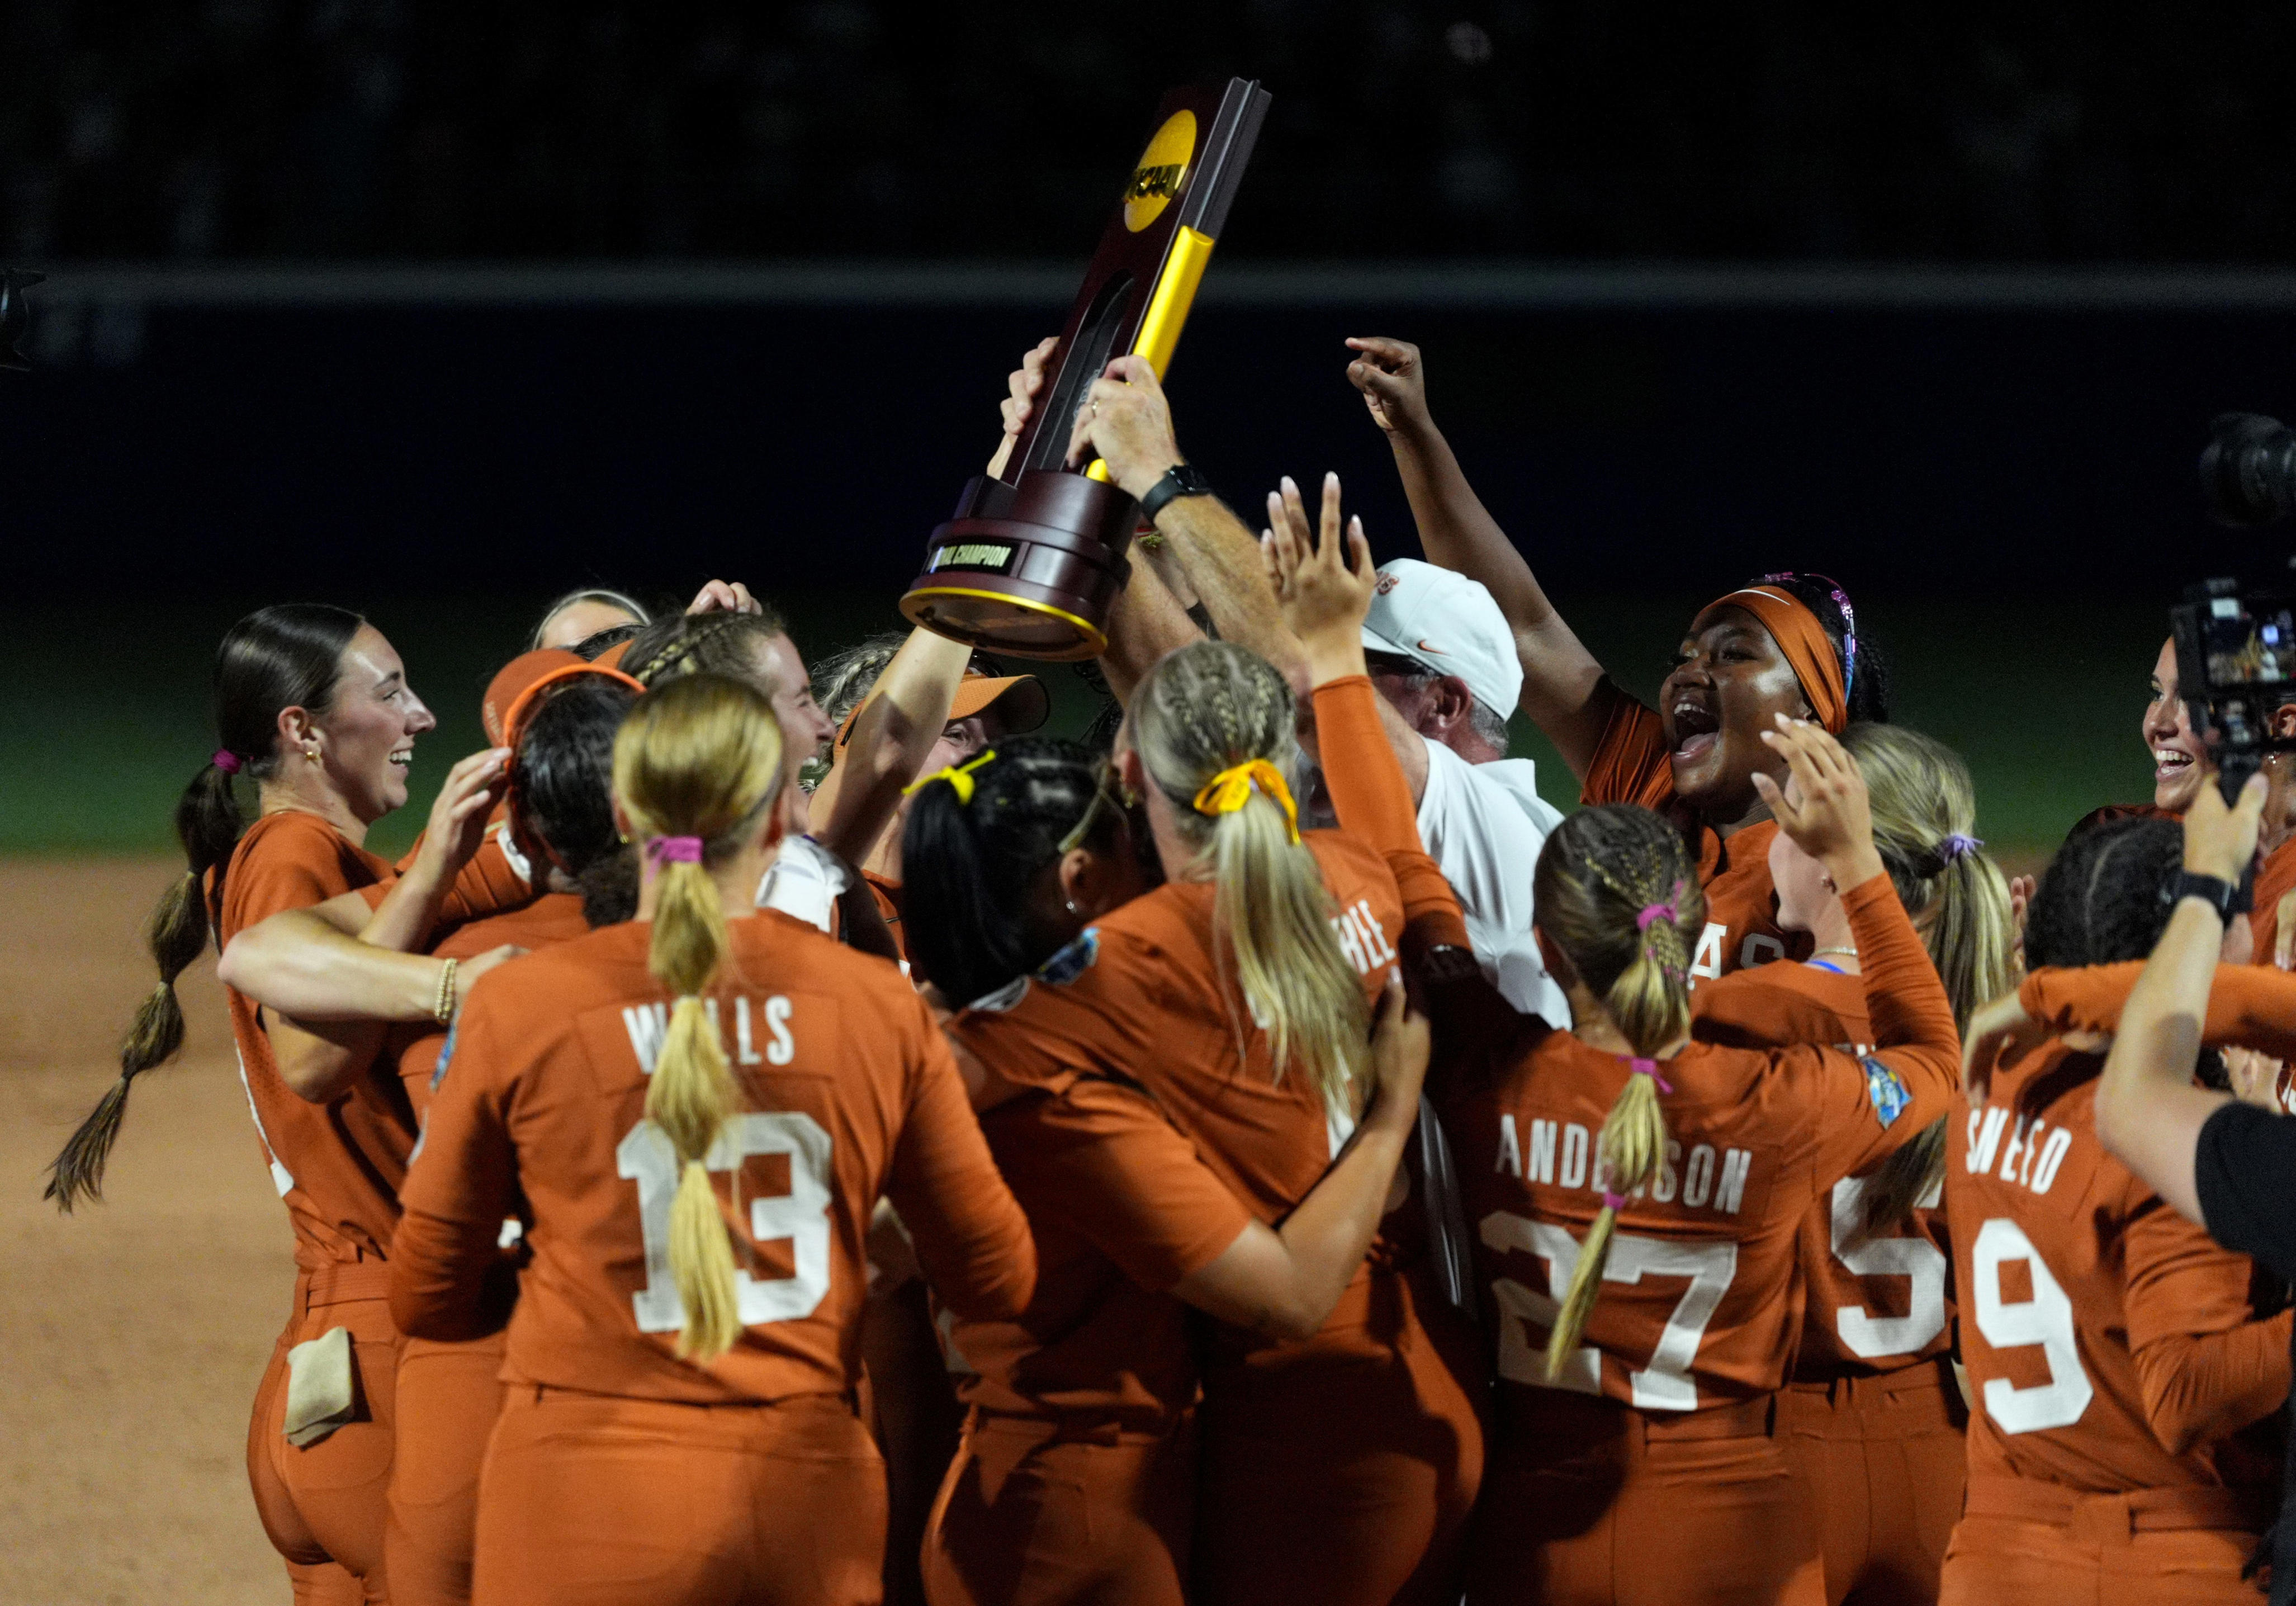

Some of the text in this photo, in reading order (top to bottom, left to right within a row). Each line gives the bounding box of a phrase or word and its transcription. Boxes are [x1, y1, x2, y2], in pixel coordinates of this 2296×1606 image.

[952, 544, 1011, 567] CHAMPION
[622, 994, 794, 1074] WLLS
[617, 1112, 832, 1333] 13
[1495, 1114, 1752, 1214] ANDESON
[1480, 1210, 1739, 1411] 27
[1831, 1176, 1947, 1358] 5
[1973, 1217, 2094, 1435] 9
